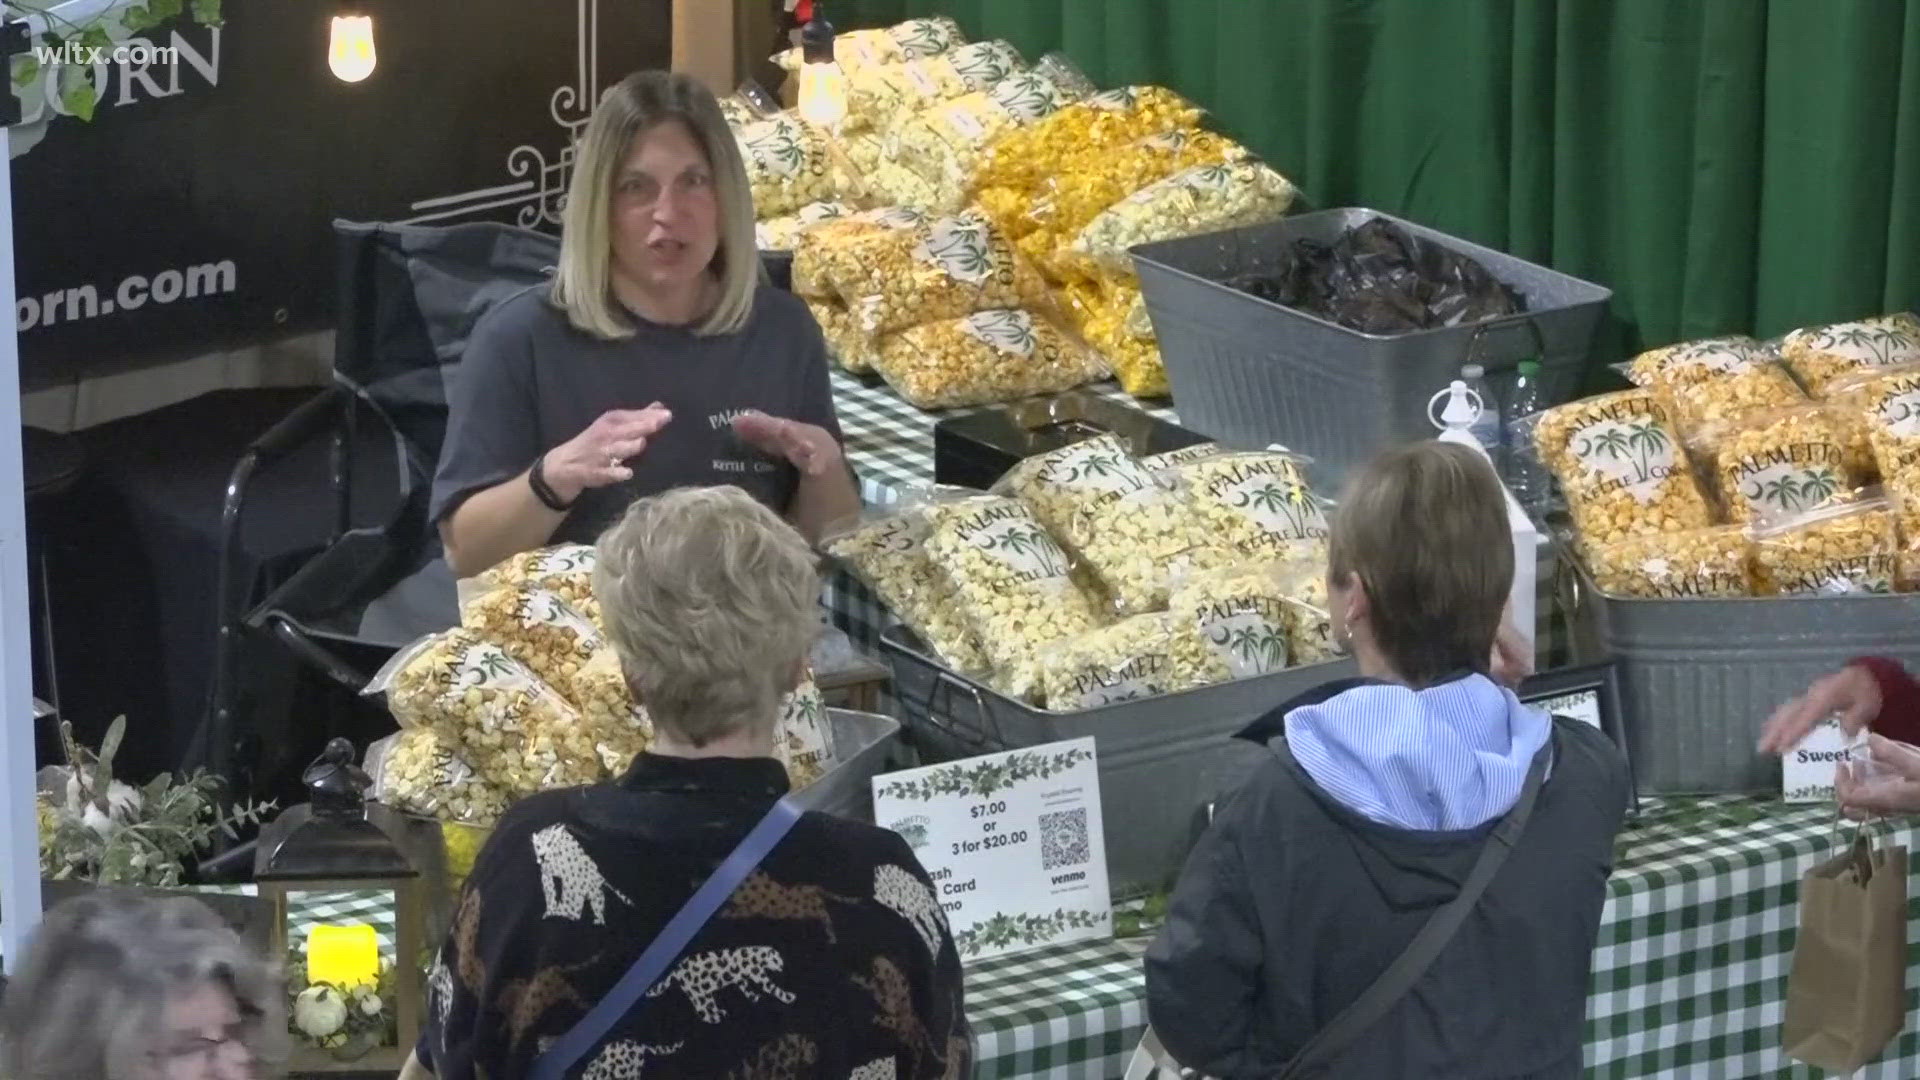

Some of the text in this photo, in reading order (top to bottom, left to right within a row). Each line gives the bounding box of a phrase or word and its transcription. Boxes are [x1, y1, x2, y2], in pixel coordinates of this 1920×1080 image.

[16, 259, 236, 332] orn.com
[1728, 441, 1843, 486] PALMETTO
[1797, 749, 1853, 764] Sweet
[970, 801, 1006, 818] $7.00
[983, 821, 997, 833] or
[952, 831, 1028, 855] 3 for $20.00
[1051, 871, 1086, 886] venmo
[943, 879, 976, 895] Card
